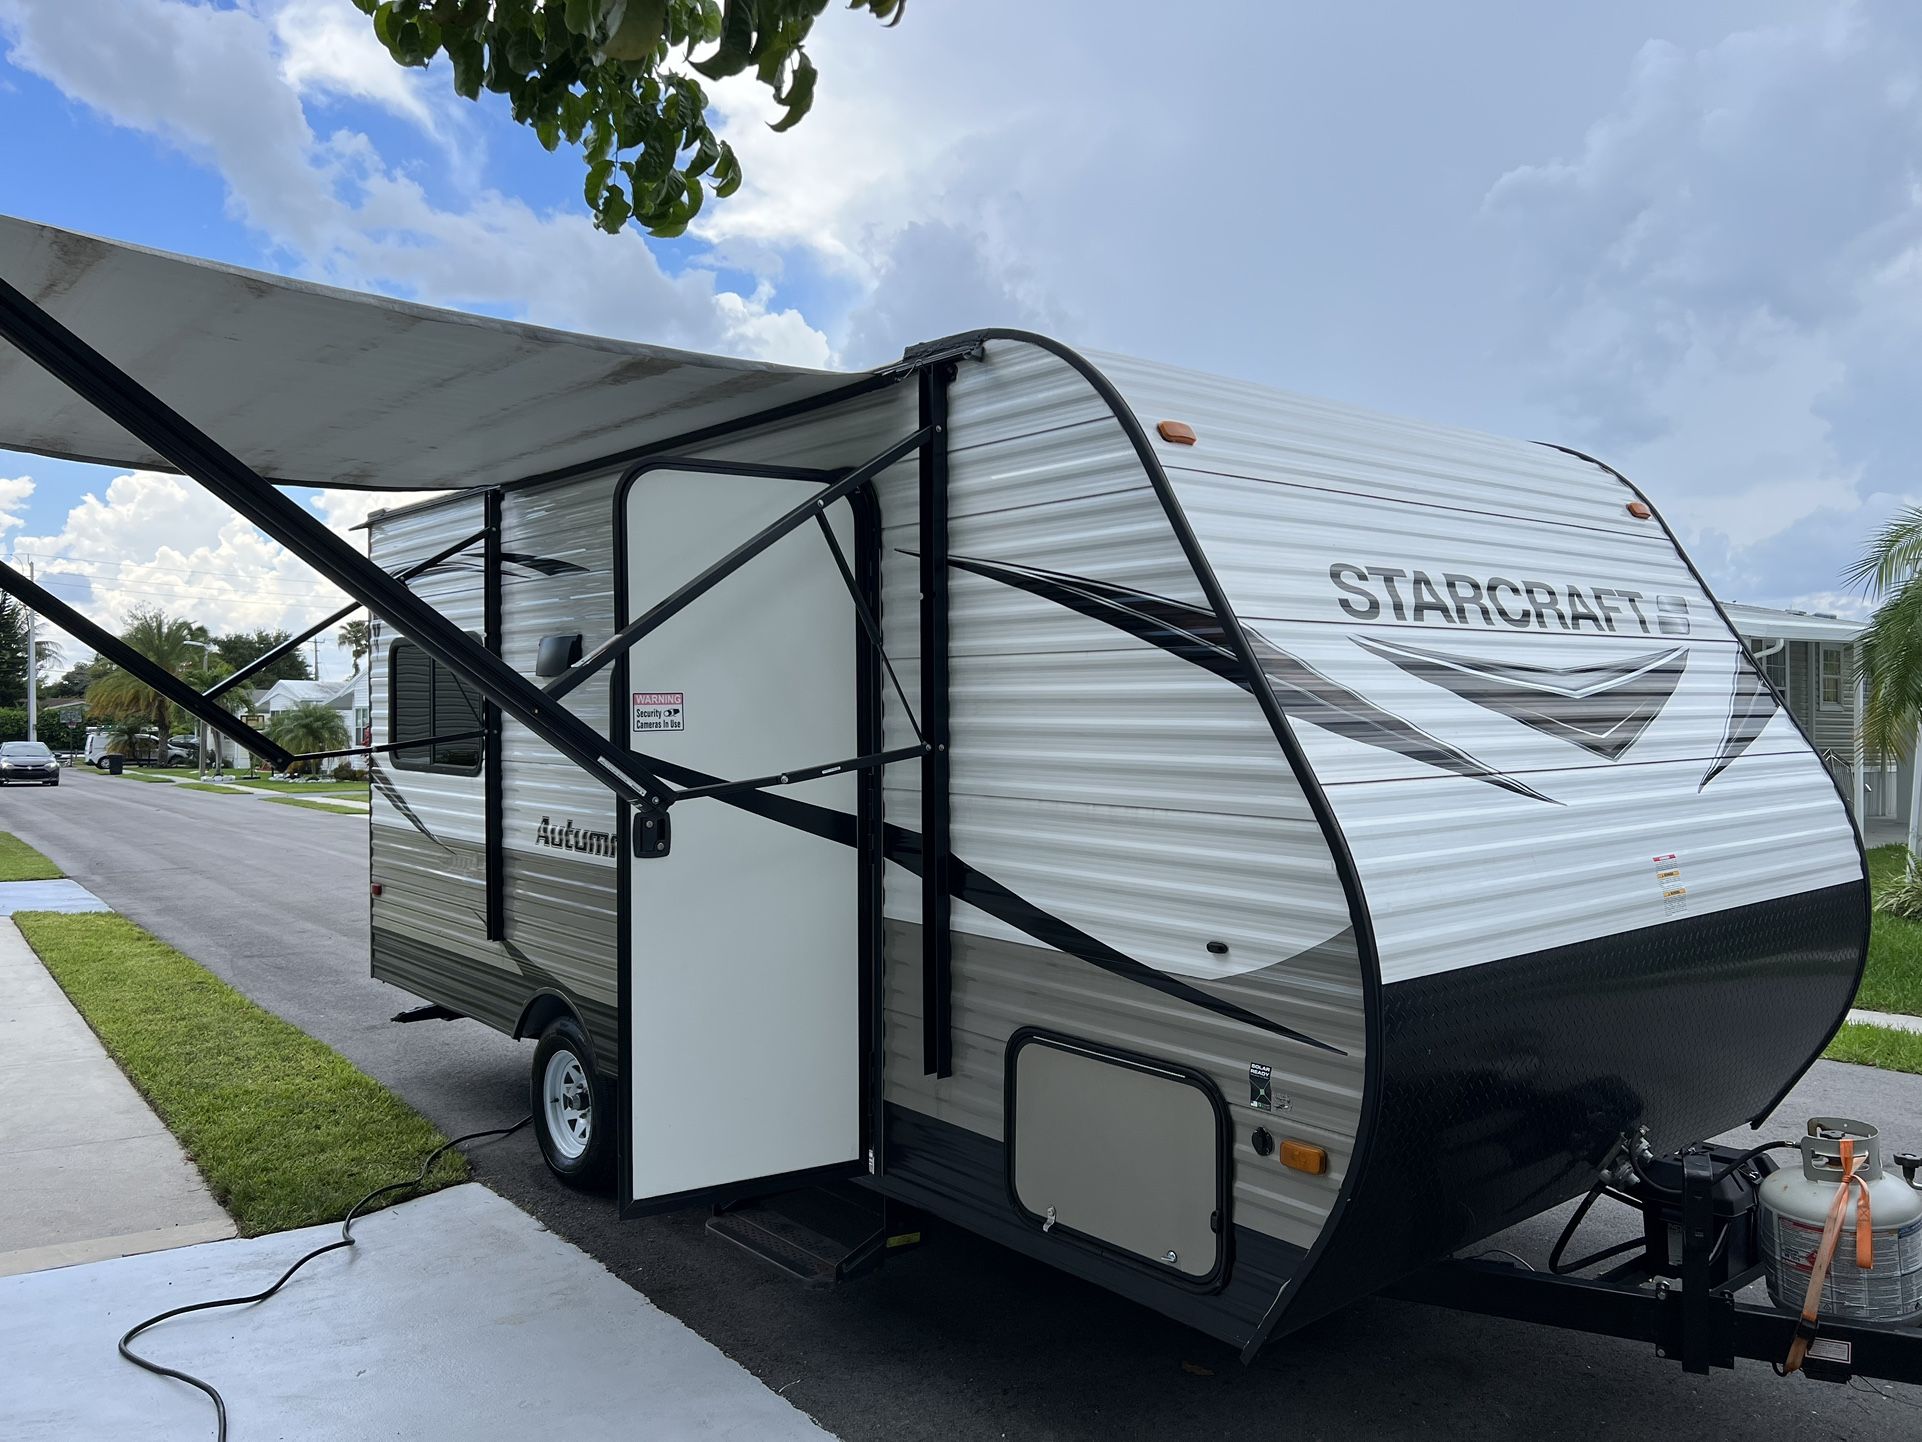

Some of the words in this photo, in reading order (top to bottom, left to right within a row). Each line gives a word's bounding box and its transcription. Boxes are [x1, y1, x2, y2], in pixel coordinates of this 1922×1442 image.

[1329, 562, 1652, 634] STARCRAFT
[636, 694, 681, 704] WARNING
[636, 708, 662, 719] Security
[636, 720, 662, 729] Cameras
[663, 720, 669, 728] In
[670, 719, 681, 728] Use
[1250, 1068, 1269, 1077] READY
[1251, 1063, 1270, 1072] SOLAR
